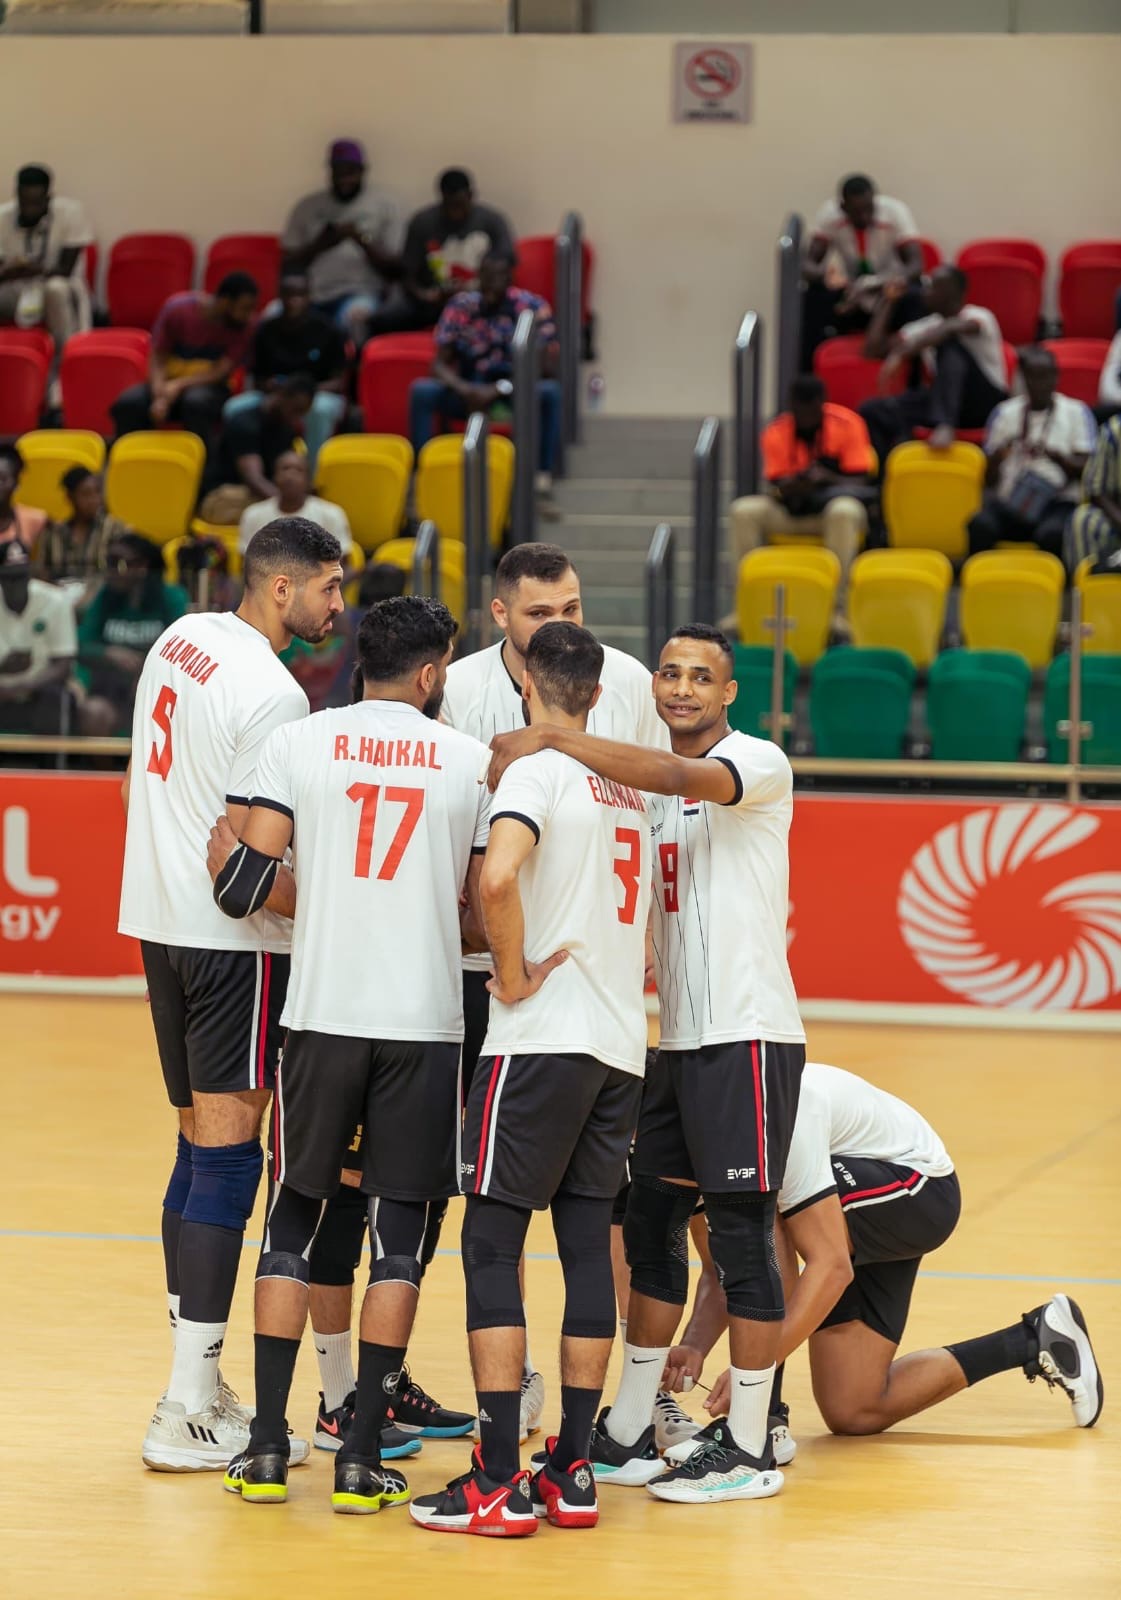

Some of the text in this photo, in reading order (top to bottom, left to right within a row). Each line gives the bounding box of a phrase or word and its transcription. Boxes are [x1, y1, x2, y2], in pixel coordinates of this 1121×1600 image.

[160, 635, 219, 685] HAMADA
[147, 685, 178, 782] 5
[334, 735, 442, 770] R.HAIKAL
[345, 782, 425, 881] 17
[614, 827, 641, 925] 3
[659, 842, 679, 912] 9
[727, 1168, 756, 1180] EVBF
[833, 1162, 857, 1187] EVBF
